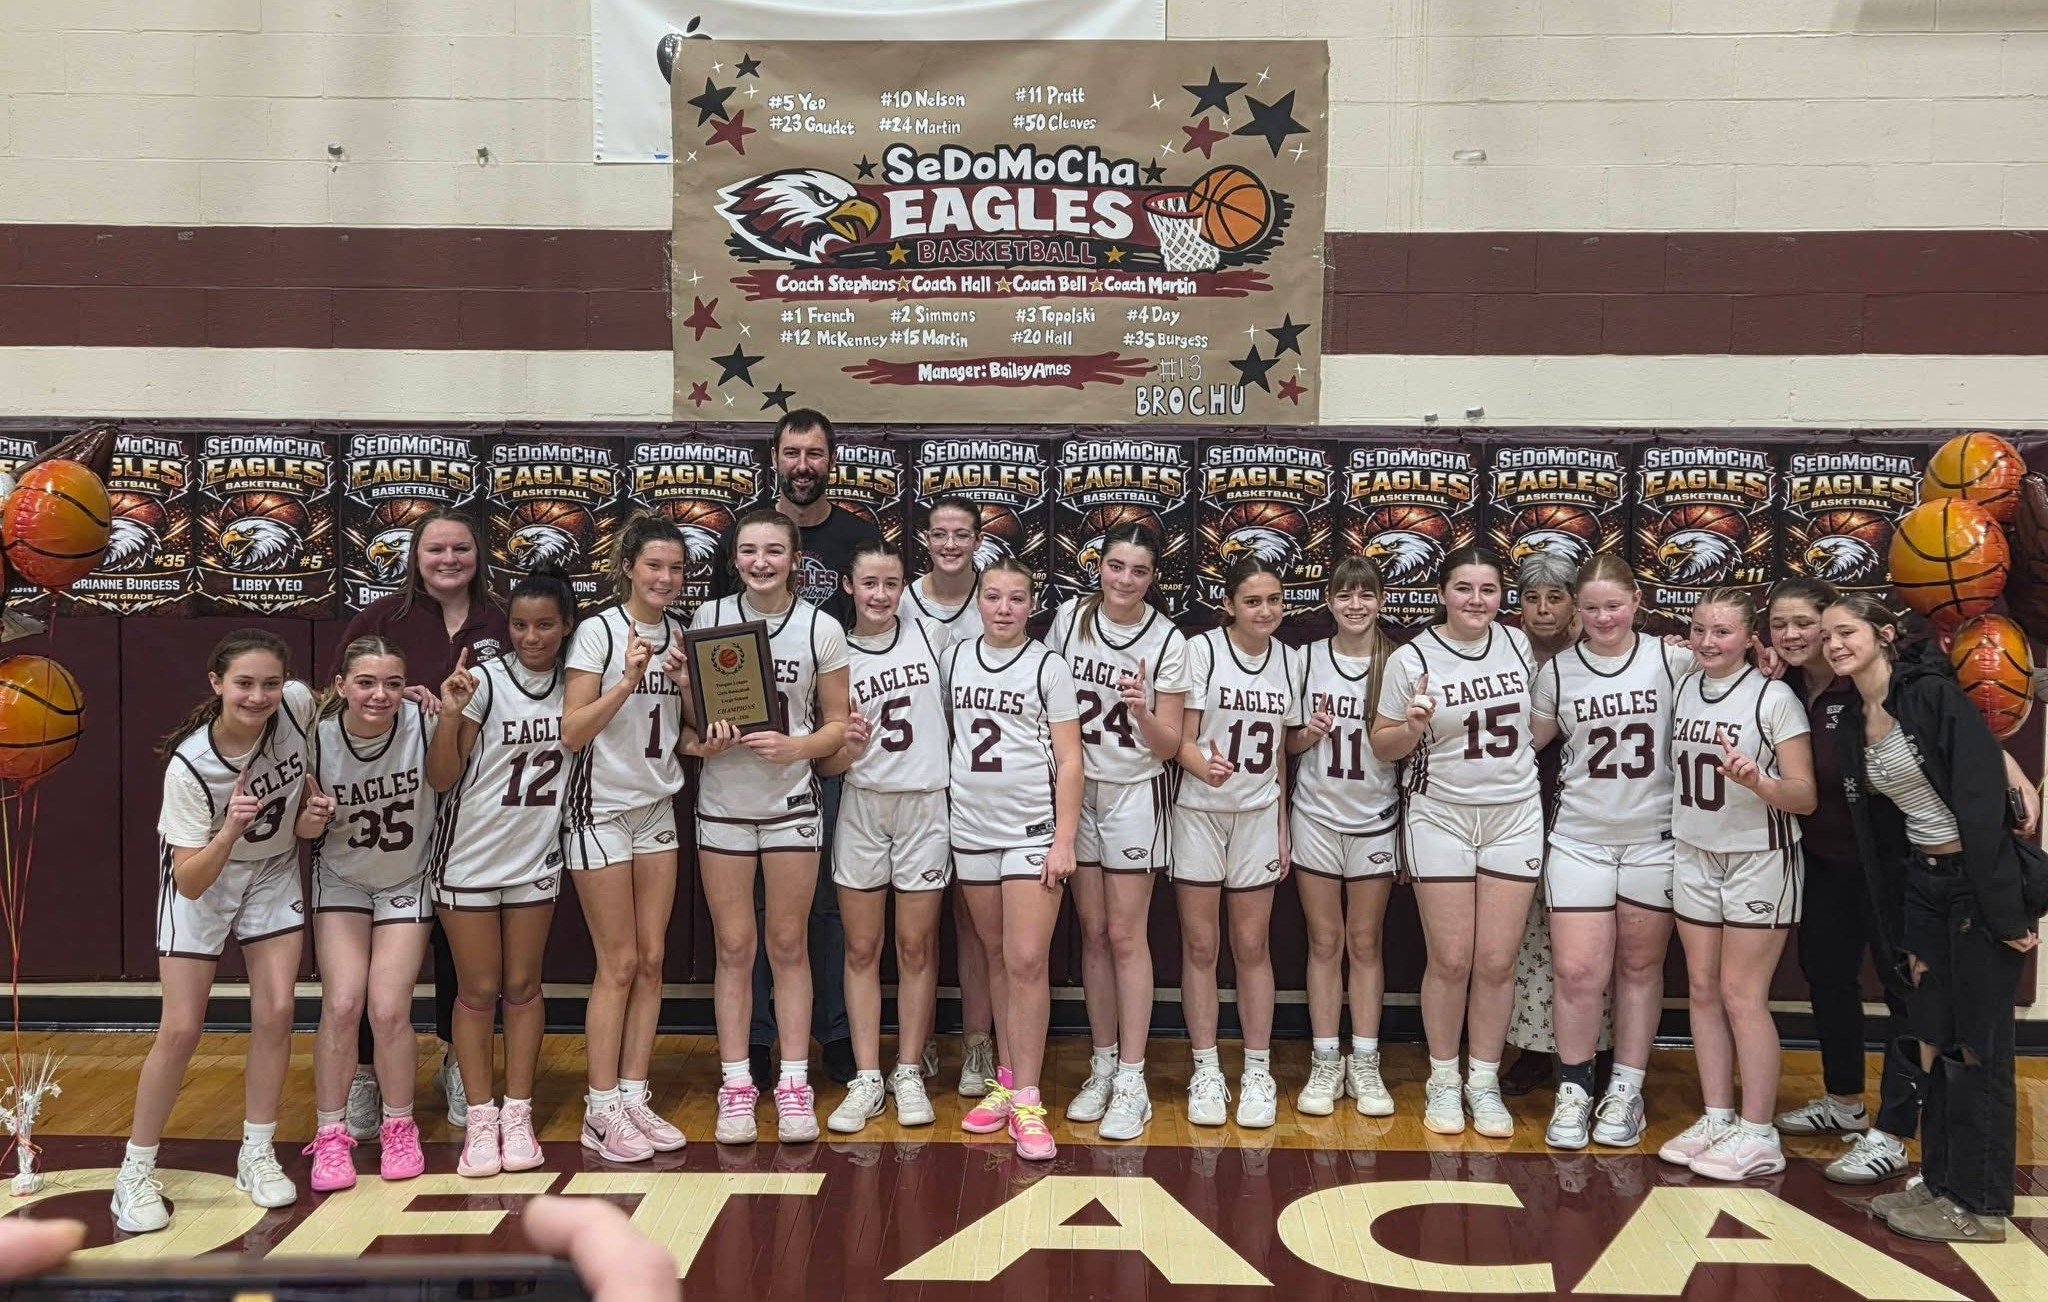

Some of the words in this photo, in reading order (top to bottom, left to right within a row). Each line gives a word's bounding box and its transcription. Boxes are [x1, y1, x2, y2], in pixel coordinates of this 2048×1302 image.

[768, 95, 795, 111] #5
[798, 93, 826, 111] Yeo
[880, 90, 912, 108] #10
[915, 90, 966, 108] Nelson
[1015, 86, 1042, 103] #11
[1047, 86, 1085, 105] Pratt
[769, 113, 802, 133] #23
[804, 116, 856, 136] Gaudet
[879, 116, 912, 132] #24
[915, 118, 961, 135] Martin
[1013, 113, 1046, 132] #50
[1048, 112, 1097, 131] Cleaves
[884, 144, 1136, 187] SeDoMoCha
[883, 185, 1135, 240] EAGLES
[916, 239, 1097, 265] BASKETBALL
[776, 274, 825, 293] Coach
[828, 274, 897, 295] Stephens
[911, 274, 957, 293] Coach
[961, 275, 990, 293] Hall
[1012, 275, 1056, 292] Coach
[1058, 275, 1087, 292] Bell
[1104, 275, 1146, 293] Coach
[1149, 276, 1198, 295] Martin
[781, 308, 802, 324] #1
[807, 307, 855, 324] French
[890, 305, 911, 324] #2
[916, 305, 976, 324] Simmons
[1015, 307, 1037, 324] #3
[1038, 306, 1096, 327] Topolski
[1126, 307, 1149, 324] #4
[1151, 305, 1181, 327] Day
[780, 329, 811, 346] #12
[817, 329, 889, 348] McKenney
[889, 328, 921, 346] #15
[922, 329, 968, 348] Martin
[1010, 328, 1042, 344] #20
[1044, 329, 1072, 346] Hall
[1123, 330, 1156, 349] #35
[1157, 332, 1209, 349] Burgess
[918, 363, 987, 383] Manager:
[1158, 354, 1203, 383] #13
[1134, 383, 1247, 417] BROCHU
[111, 457, 184, 487] GLES
[206, 457, 328, 482] EAGLES
[352, 458, 472, 493] EAGLES
[494, 465, 613, 496] EAGLES
[636, 465, 754, 496] EAGLES
[922, 464, 1041, 496] EAGLES
[1063, 464, 1183, 496] EAGLES
[1207, 467, 1327, 495] EAGLES
[225, 481, 304, 491] BASKETBALL
[371, 485, 449, 499] BASKETBALL
[513, 488, 590, 500] BASKETBALL
[654, 488, 731, 499] BASKETBALL
[1226, 490, 1304, 501] BASKETBALL
[1351, 470, 1471, 500] EAGLES
[1498, 470, 1619, 499] EAGLES
[1646, 470, 1767, 500] EAGLES
[1791, 475, 1916, 504] EAGLES
[1083, 491, 1160, 504] BASKETBALL
[1370, 493, 1448, 505] BASKETBALL
[1517, 492, 1596, 503] BASKETBALL
[1665, 492, 1745, 503] BASKETBALL
[1811, 498, 1891, 509] BASKETBALL
[154, 554, 186, 568] #35
[299, 554, 323, 569] #5
[1295, 564, 1323, 578] #10
[126, 577, 181, 591] BURGESS
[232, 577, 272, 591] LIBBY
[274, 577, 303, 592] YEO
[1734, 567, 1765, 583] #11
[237, 593, 259, 601] 7TH
[261, 593, 296, 601] GRADE
[1282, 588, 1320, 601] ELSON
[1409, 591, 1439, 604] CLEA
[853, 662, 930, 705] EAGLES
[1442, 670, 1525, 708] EAGLES
[954, 686, 1025, 715] EAGLES
[1219, 686, 1285, 715] EAGLES
[1573, 689, 1659, 723] EAGLES
[880, 695, 914, 753] 5
[1076, 688, 1136, 748] 24
[644, 703, 662, 759] 1
[1463, 702, 1521, 760] 15
[970, 717, 1003, 773] 2
[1228, 719, 1275, 775] 13
[1326, 725, 1365, 780] 11
[1586, 722, 1656, 780] 23
[243, 751, 303, 801] GLES
[332, 767, 420, 807] EAGLES
[500, 750, 563, 807] 12
[1677, 750, 1726, 812] 10
[347, 799, 415, 853] 35
